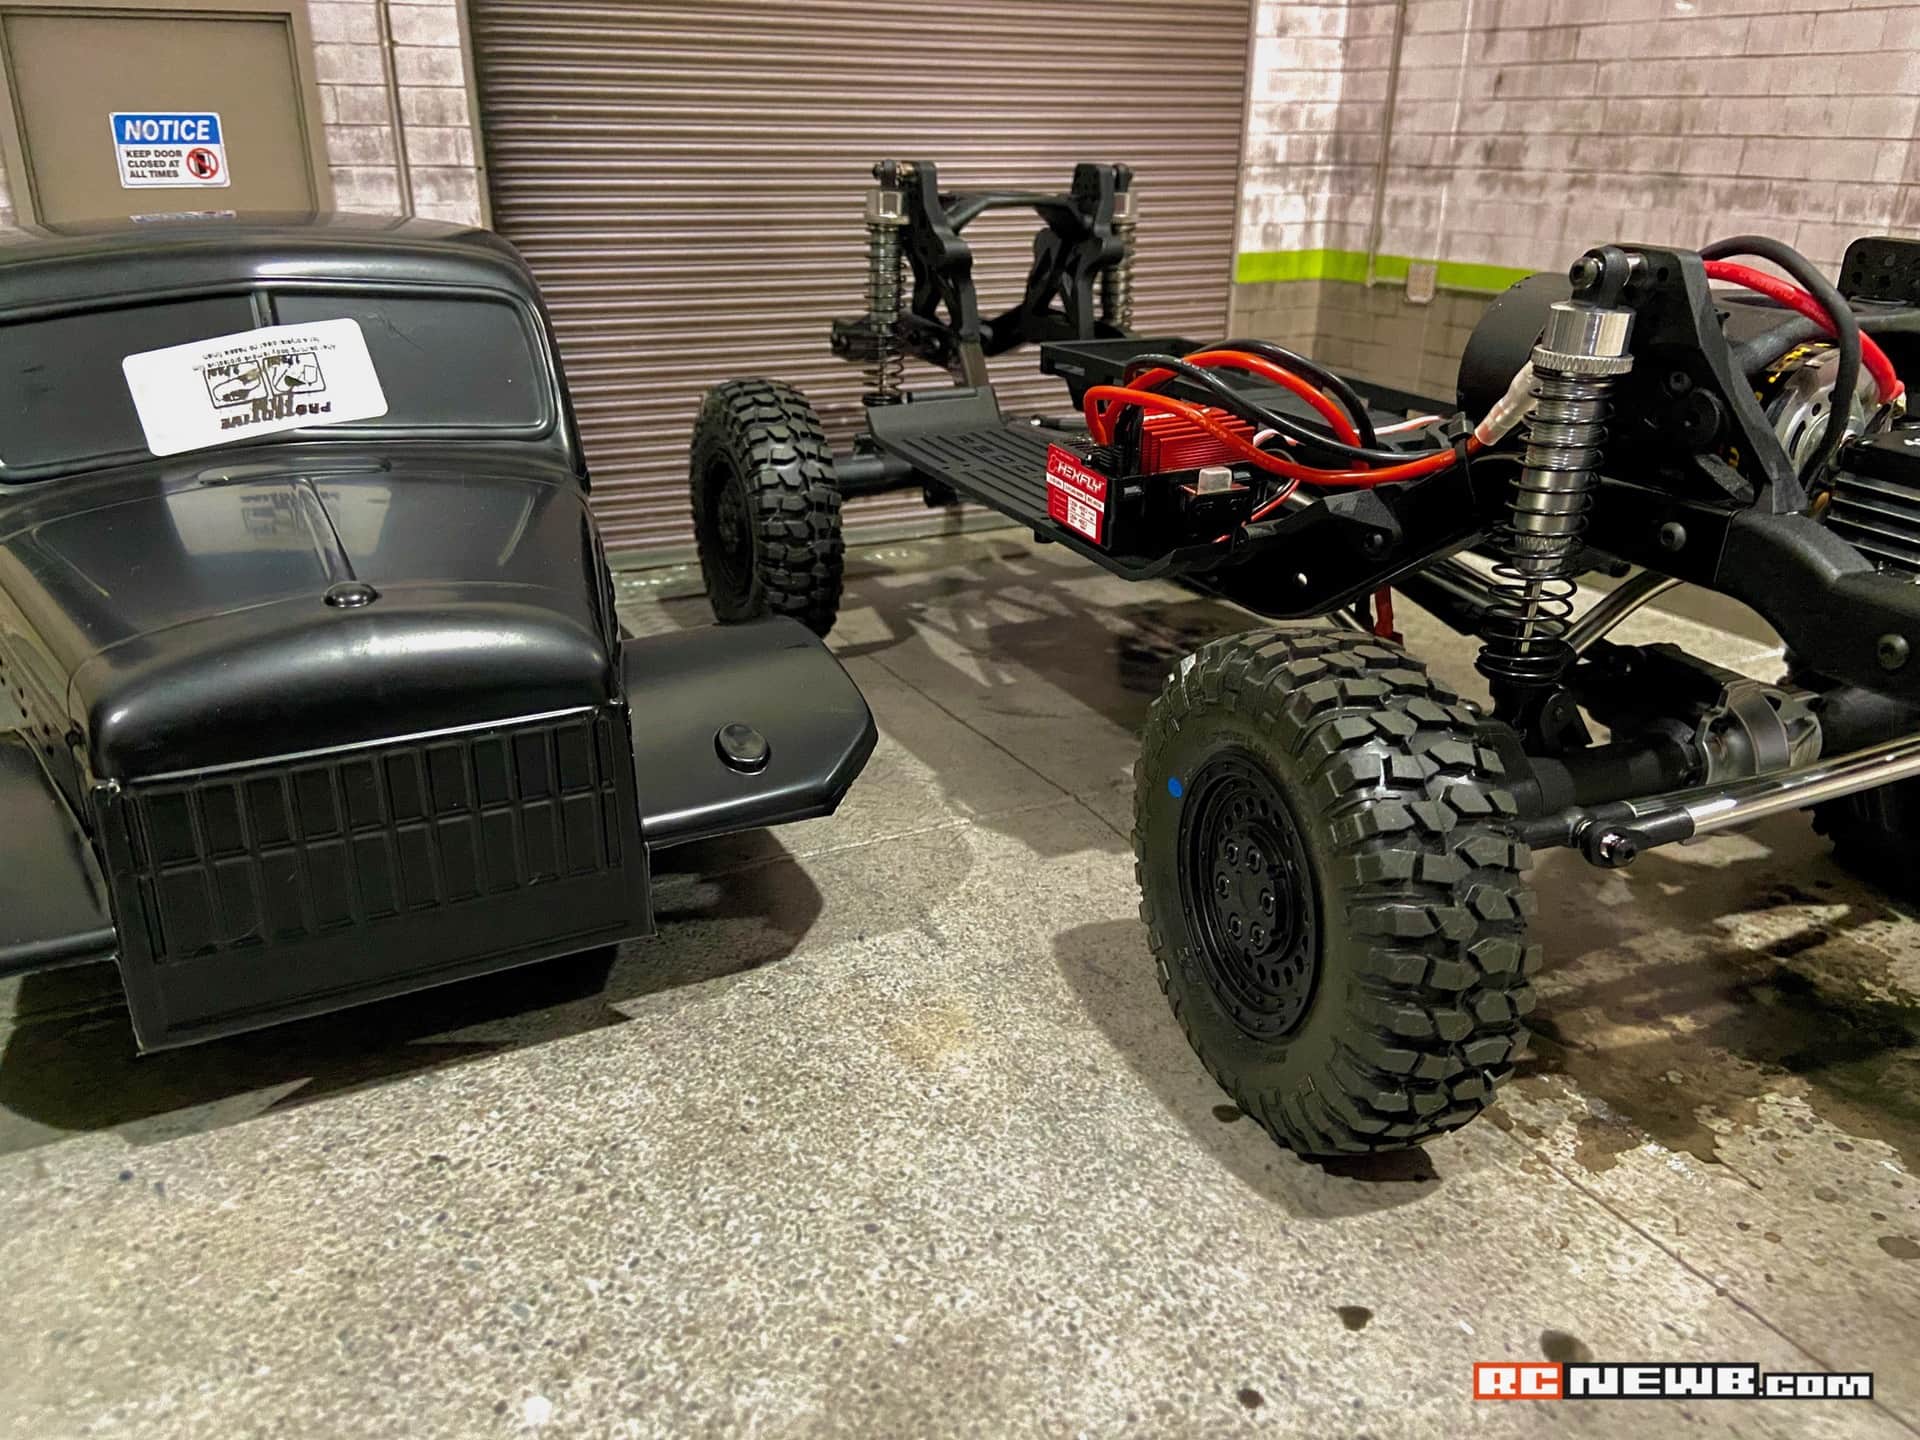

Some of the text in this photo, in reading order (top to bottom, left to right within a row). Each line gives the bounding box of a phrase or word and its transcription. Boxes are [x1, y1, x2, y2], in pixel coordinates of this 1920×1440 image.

[124, 119, 210, 141] NOTICE
[128, 160, 180, 168] CLOSED AT
[130, 170, 179, 178] ALL TIMES
[1056, 462, 1103, 493] HEXFLY
